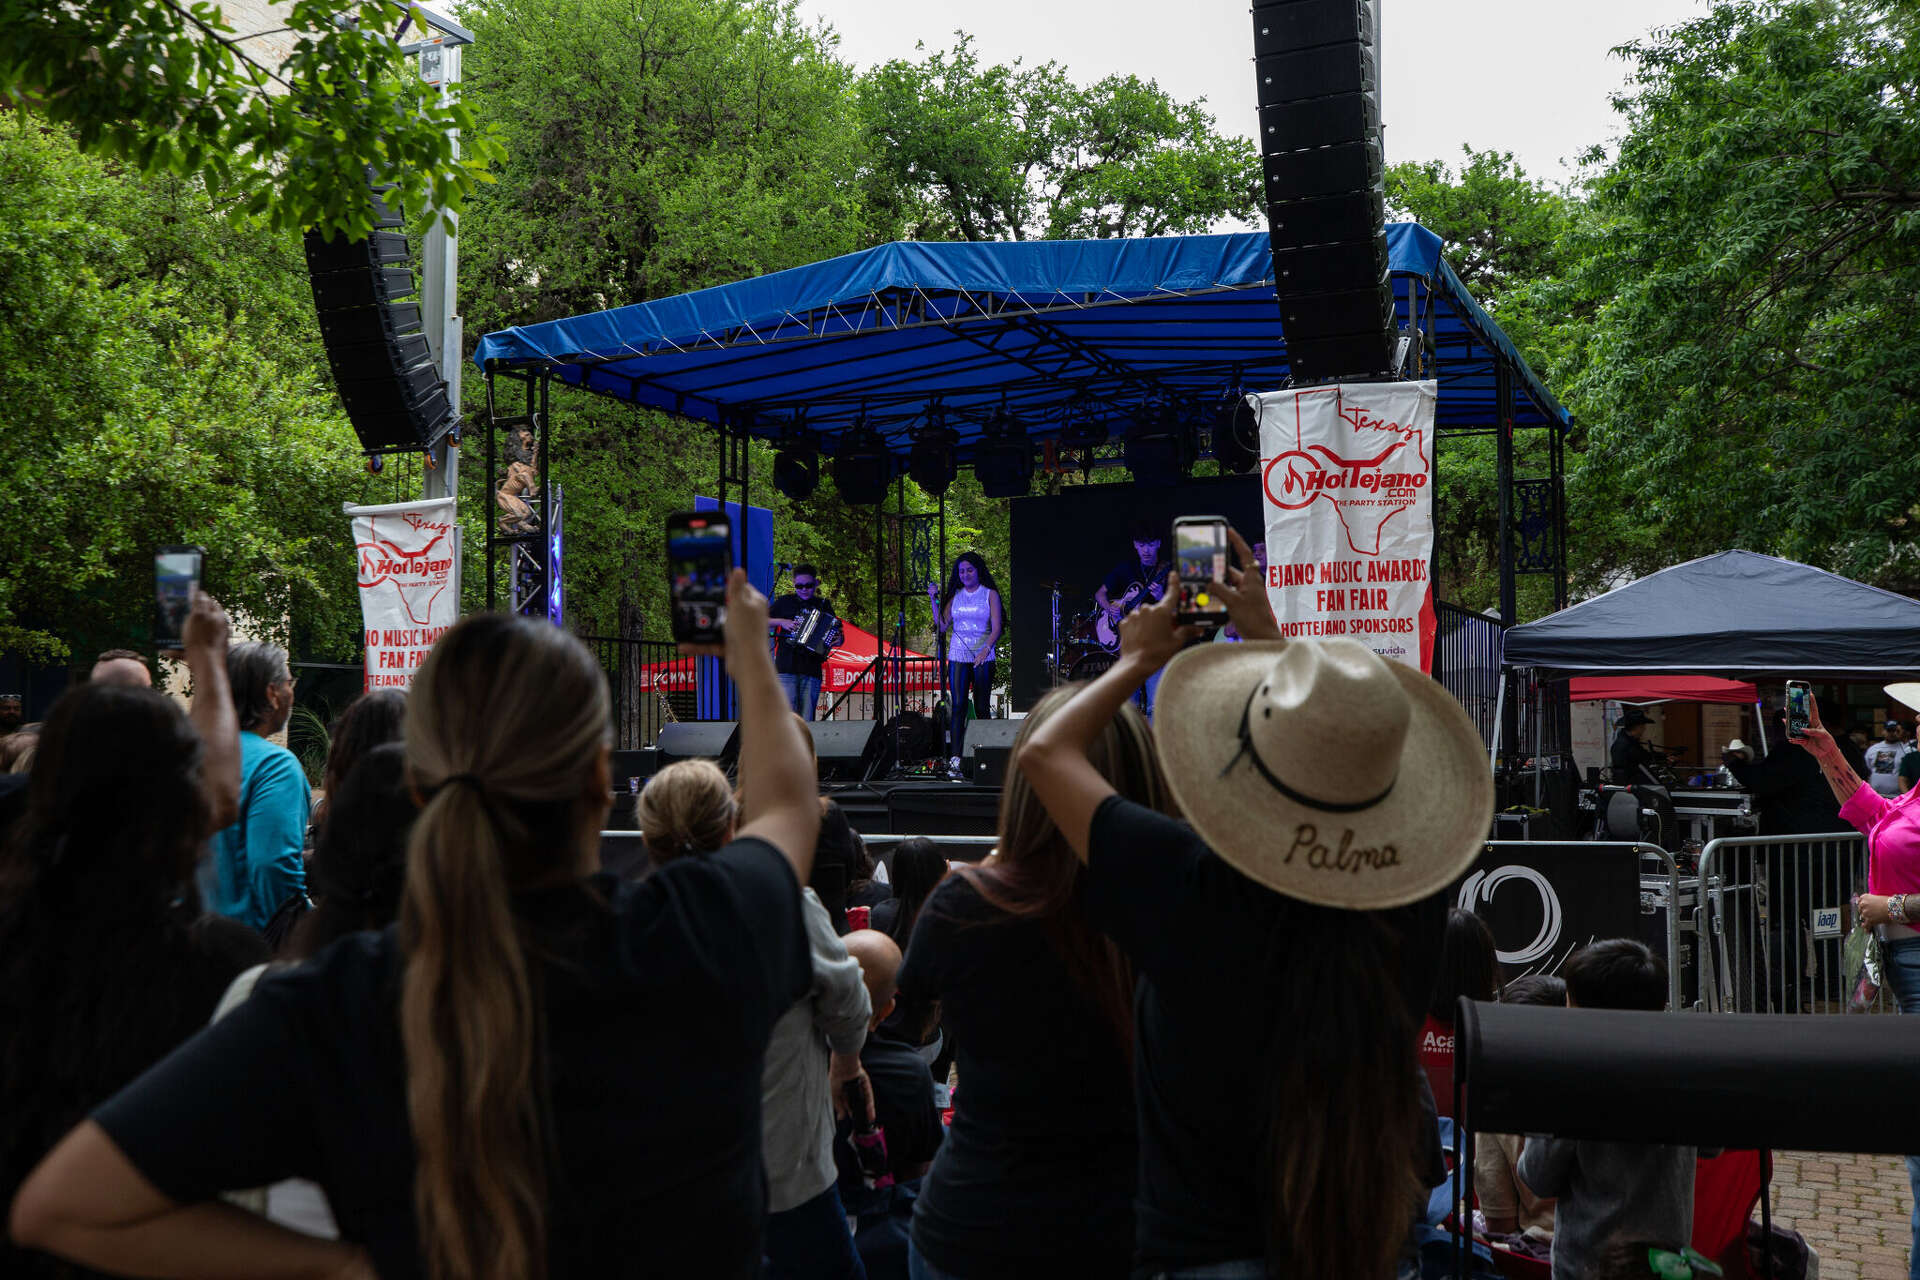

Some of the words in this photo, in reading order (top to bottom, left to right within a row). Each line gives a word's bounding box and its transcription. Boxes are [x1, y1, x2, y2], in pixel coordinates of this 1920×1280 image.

[1344, 406, 1413, 441] Texas
[1304, 463, 1428, 494] HotTejano
[1377, 499, 1416, 507] STATION
[1385, 488, 1416, 498] .com
[1268, 563, 1315, 589] EJANO
[1320, 560, 1363, 584] MUSIC
[1367, 559, 1427, 583] AWARDS
[1316, 589, 1345, 612] FAN
[1350, 588, 1389, 612] FAIR
[383, 629, 418, 647] MUSIC
[1281, 620, 1346, 639] HOTTEJANO
[1350, 617, 1414, 635] SPONSORS
[379, 651, 405, 669] FAN
[1283, 823, 1400, 873] Palma
